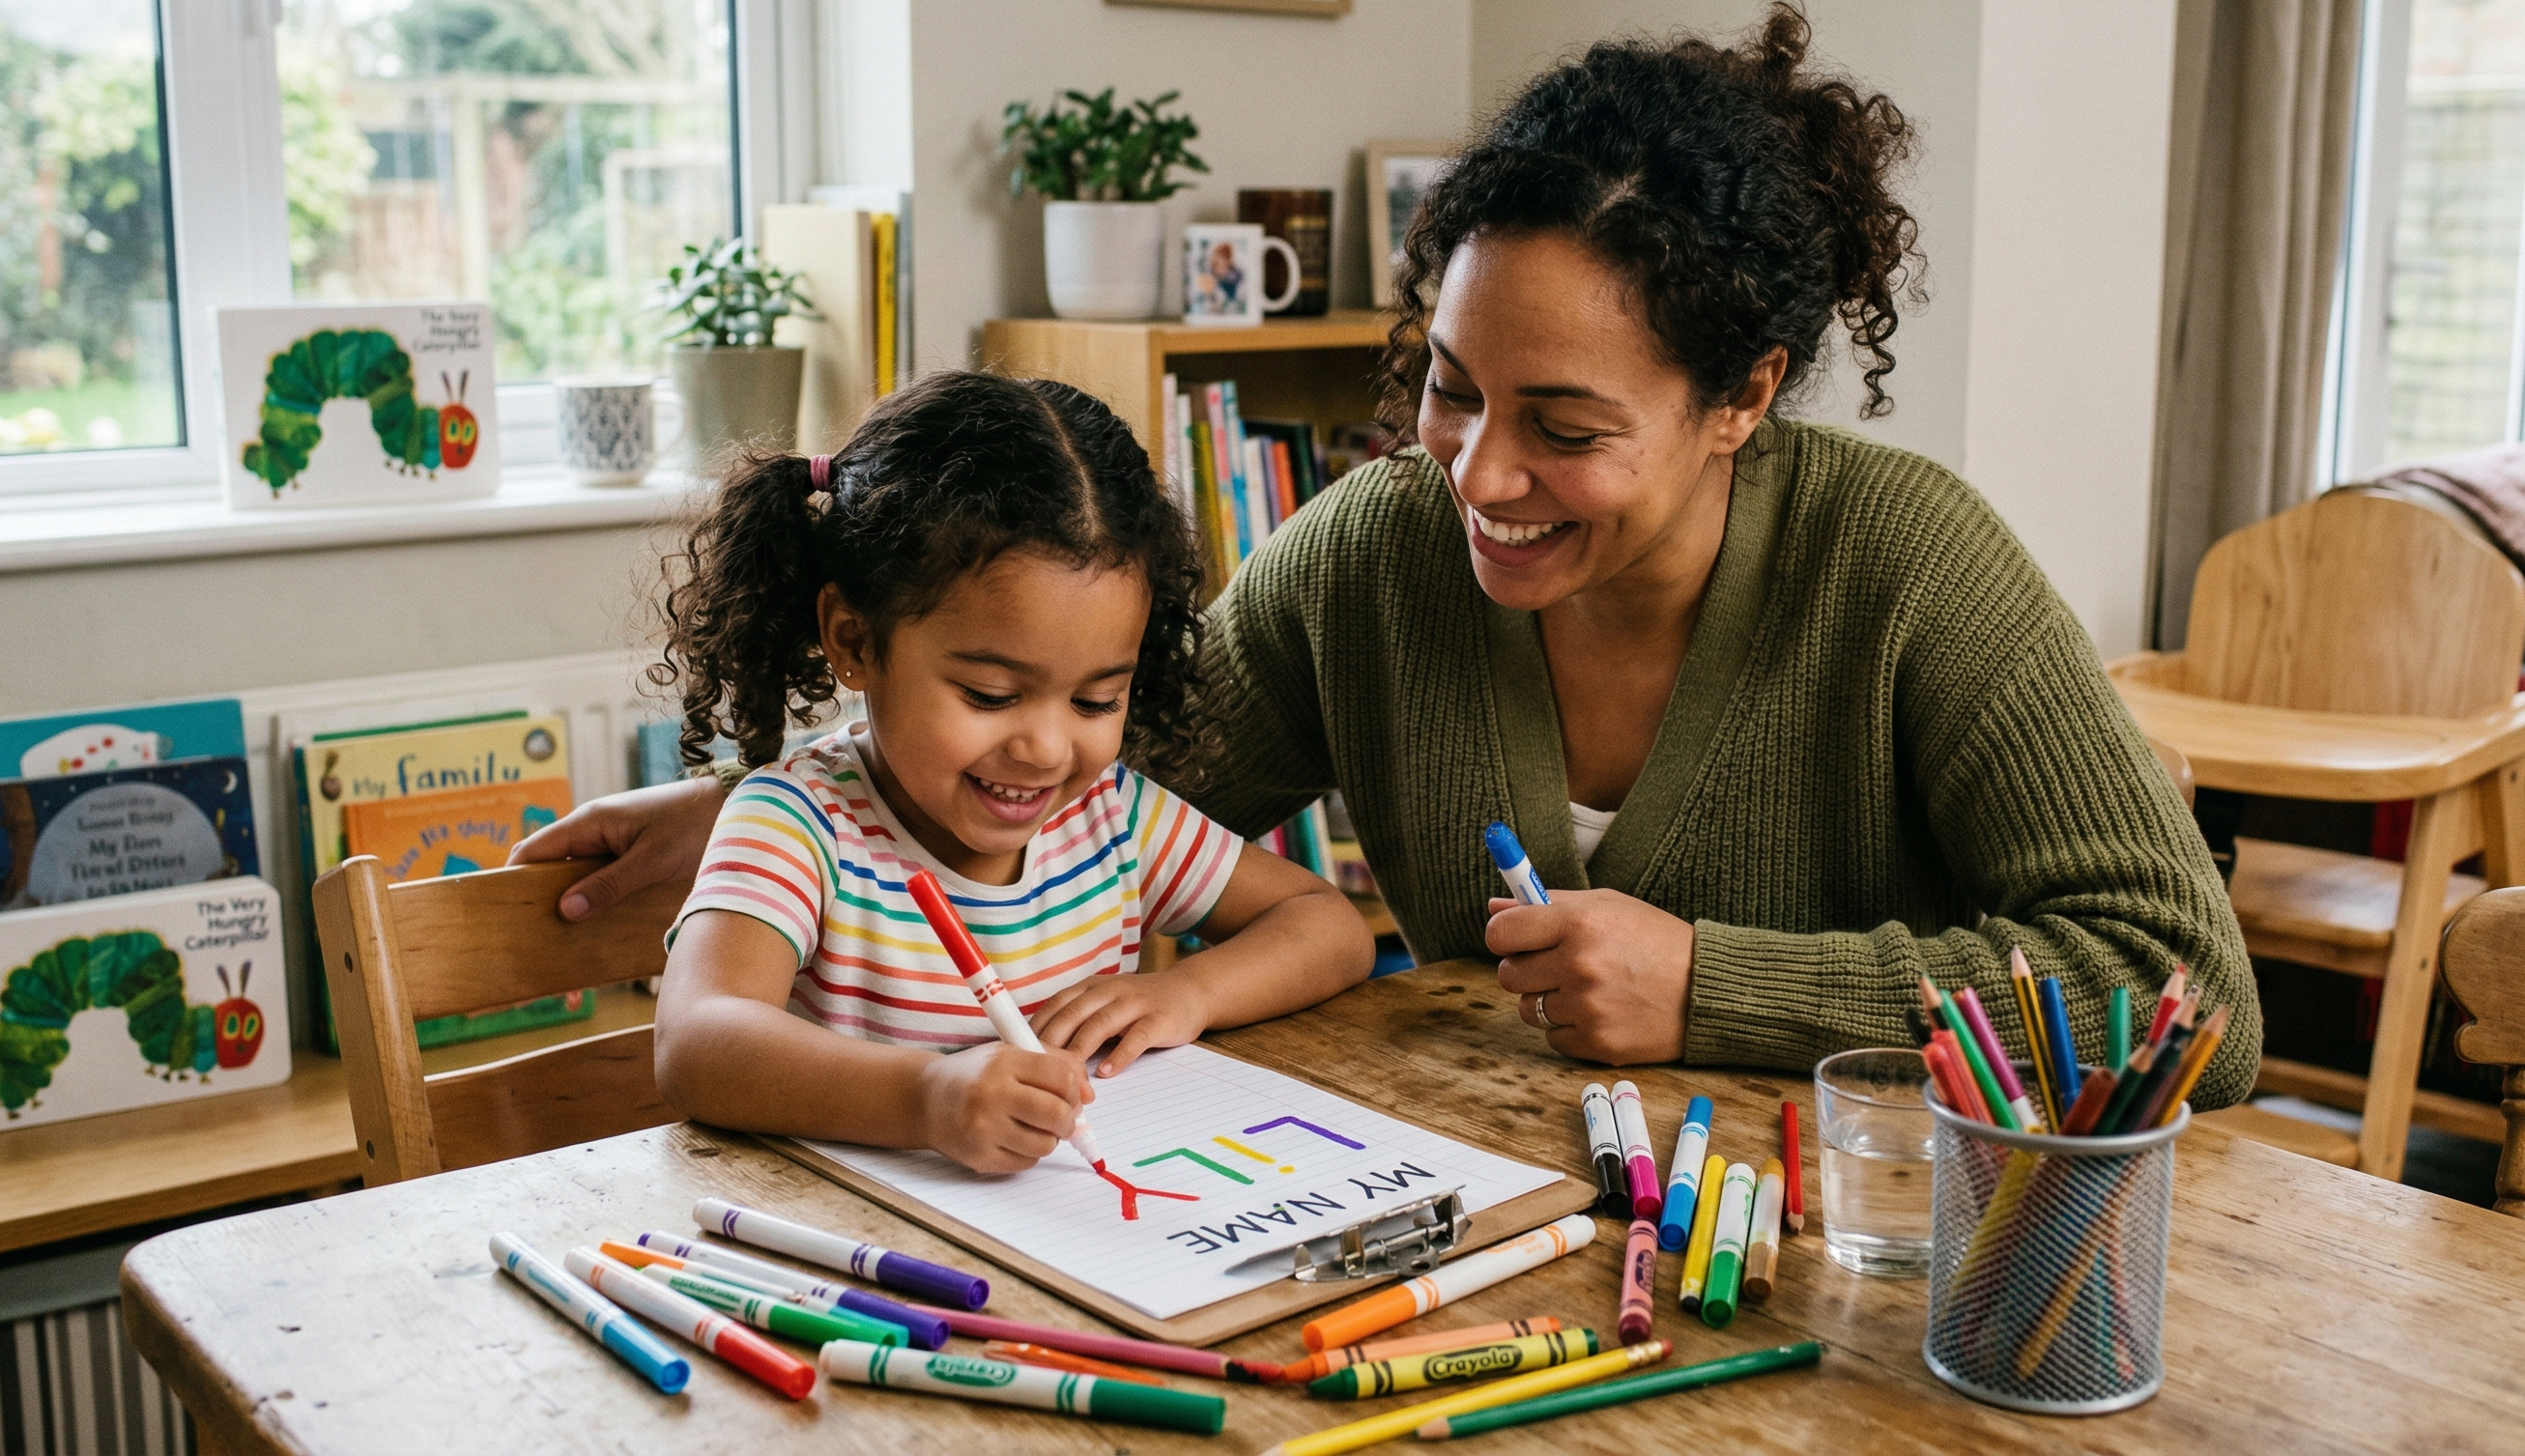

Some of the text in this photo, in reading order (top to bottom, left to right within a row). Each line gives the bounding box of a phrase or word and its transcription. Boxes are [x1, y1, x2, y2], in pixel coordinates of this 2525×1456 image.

[197, 897, 266, 916] The Very
[208, 915, 267, 932] Hungry
[1166, 1161, 1437, 1255] MY NAME
[1430, 1347, 1514, 1378] Crayola
